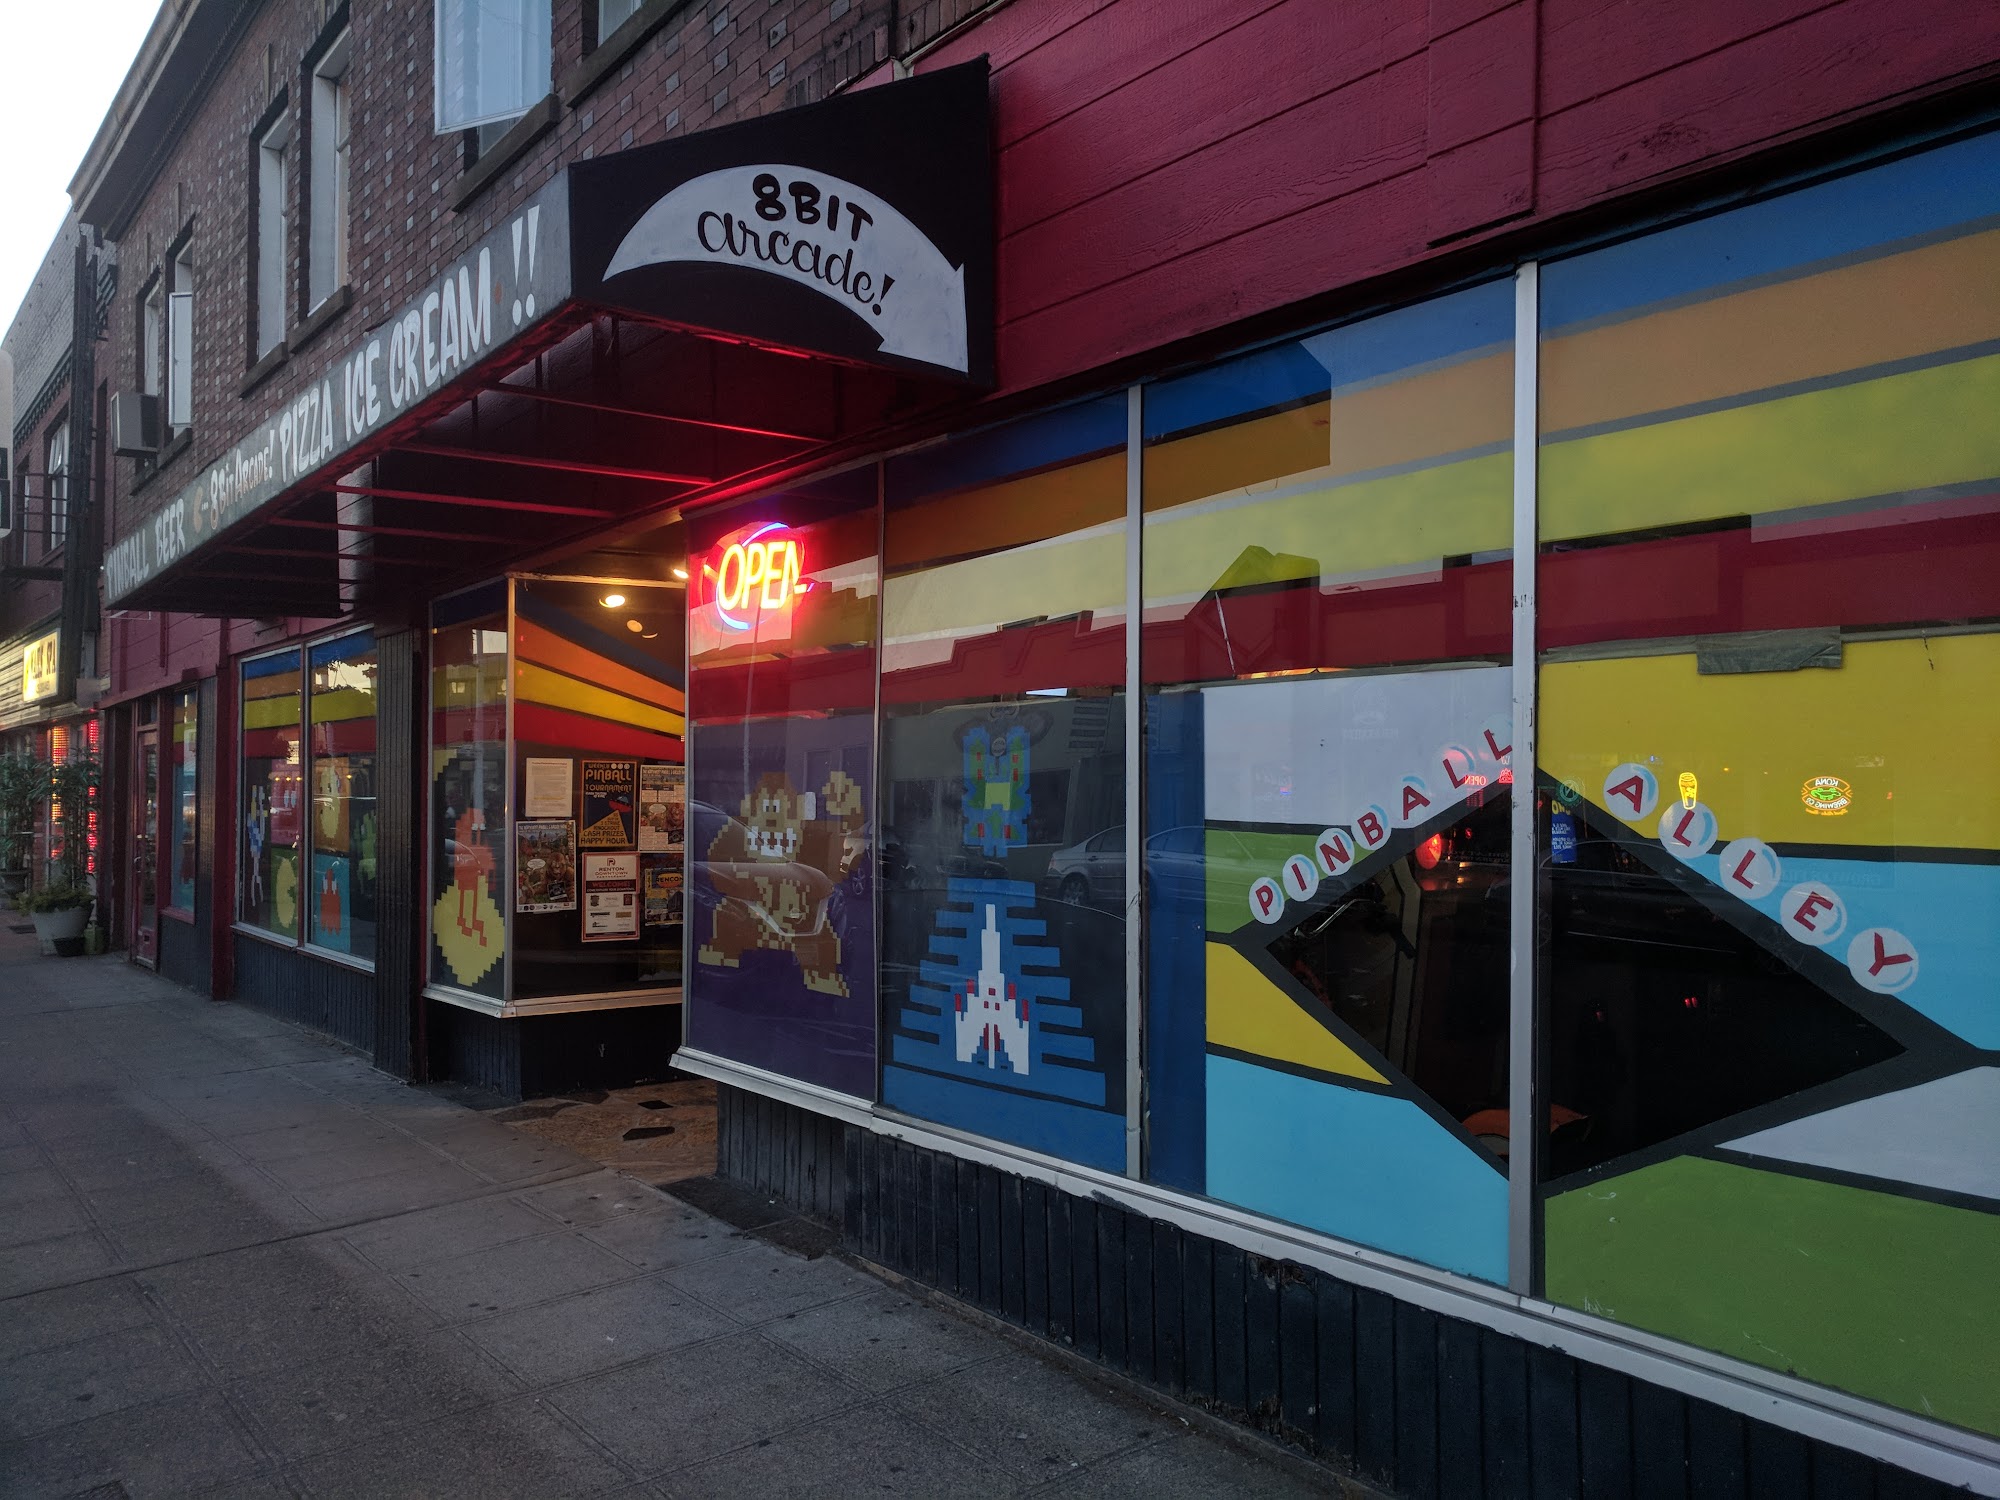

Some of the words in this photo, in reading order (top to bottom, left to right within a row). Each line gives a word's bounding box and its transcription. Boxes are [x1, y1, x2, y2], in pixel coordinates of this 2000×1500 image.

[752, 173, 873, 241] 8BIT
[697, 210, 896, 316] arcade!
[106, 529, 149, 599] PINBALL
[154, 498, 186, 567] BEER
[279, 380, 334, 482] PIZZA
[345, 339, 381, 441] ICE
[388, 247, 492, 409] CREAM
[718, 540, 805, 611] OPEN
[585, 769, 631, 783] PINBALL
[585, 784, 632, 794] TOURNAMENT
[581, 837, 604, 845] HAPPY
[1255, 727, 1513, 917] PINBALL
[1606, 775, 1913, 977] ALLEY
